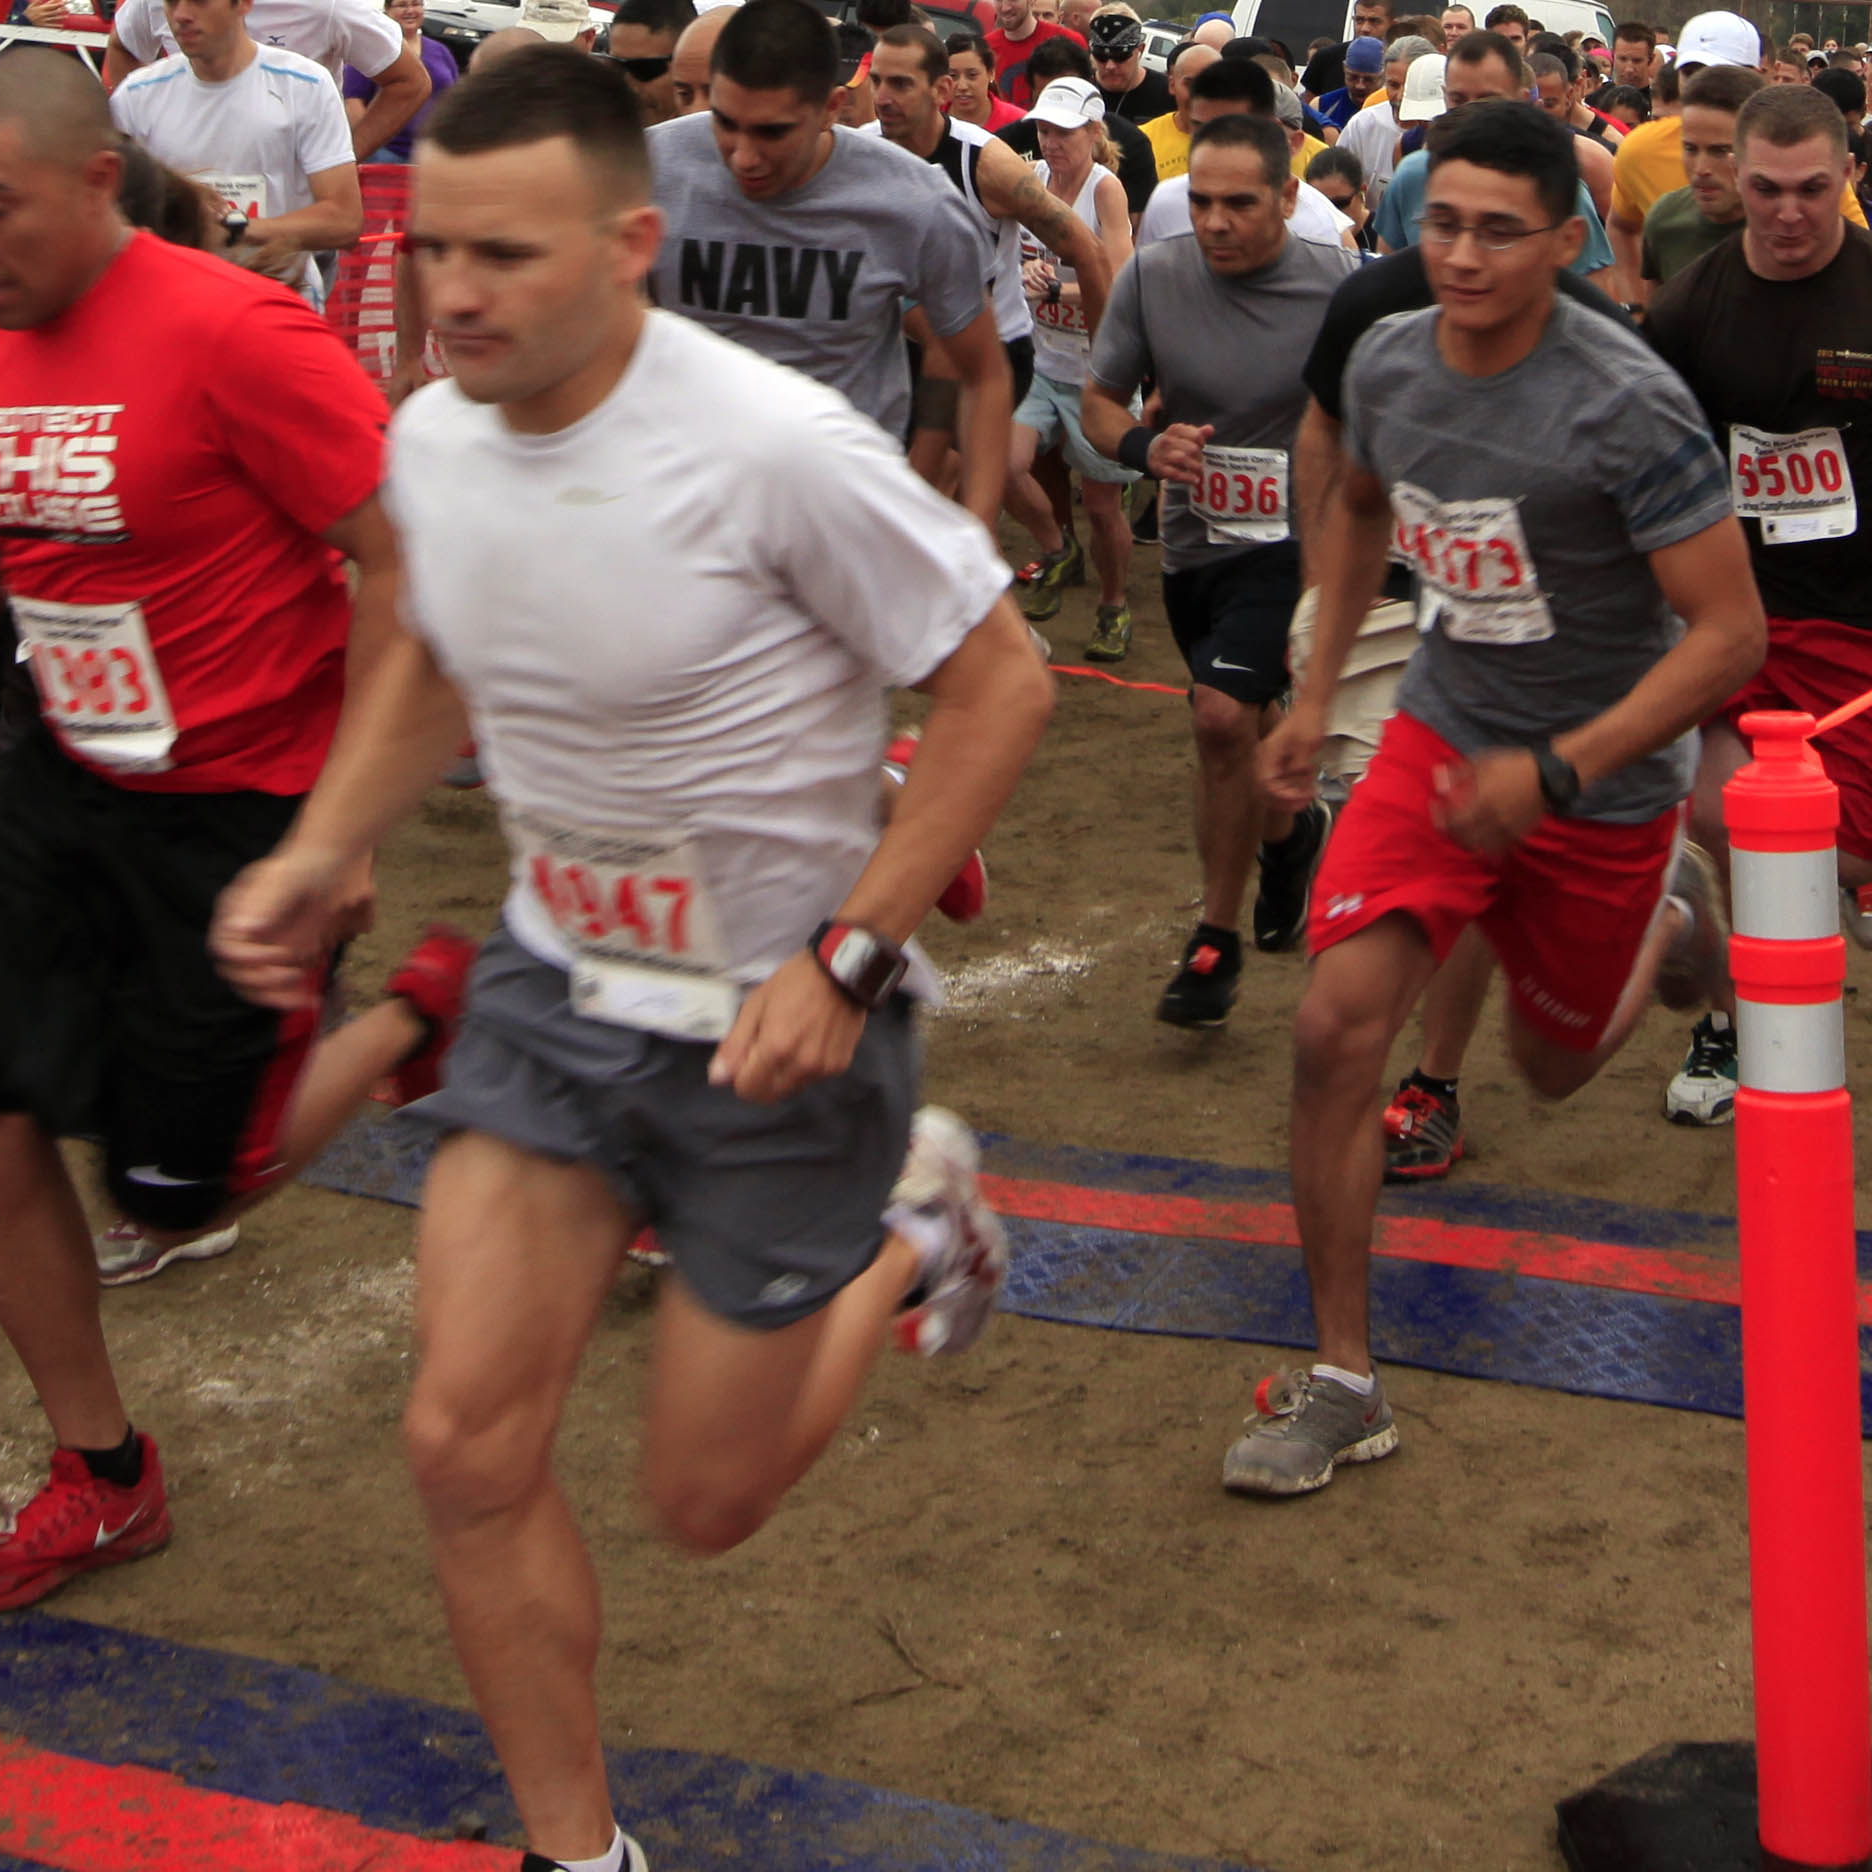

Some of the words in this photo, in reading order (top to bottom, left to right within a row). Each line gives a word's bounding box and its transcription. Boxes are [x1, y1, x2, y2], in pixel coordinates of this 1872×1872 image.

[680, 238, 867, 321] NAVY
[1191, 471, 1279, 516] 3836
[1737, 448, 1843, 497] 5500
